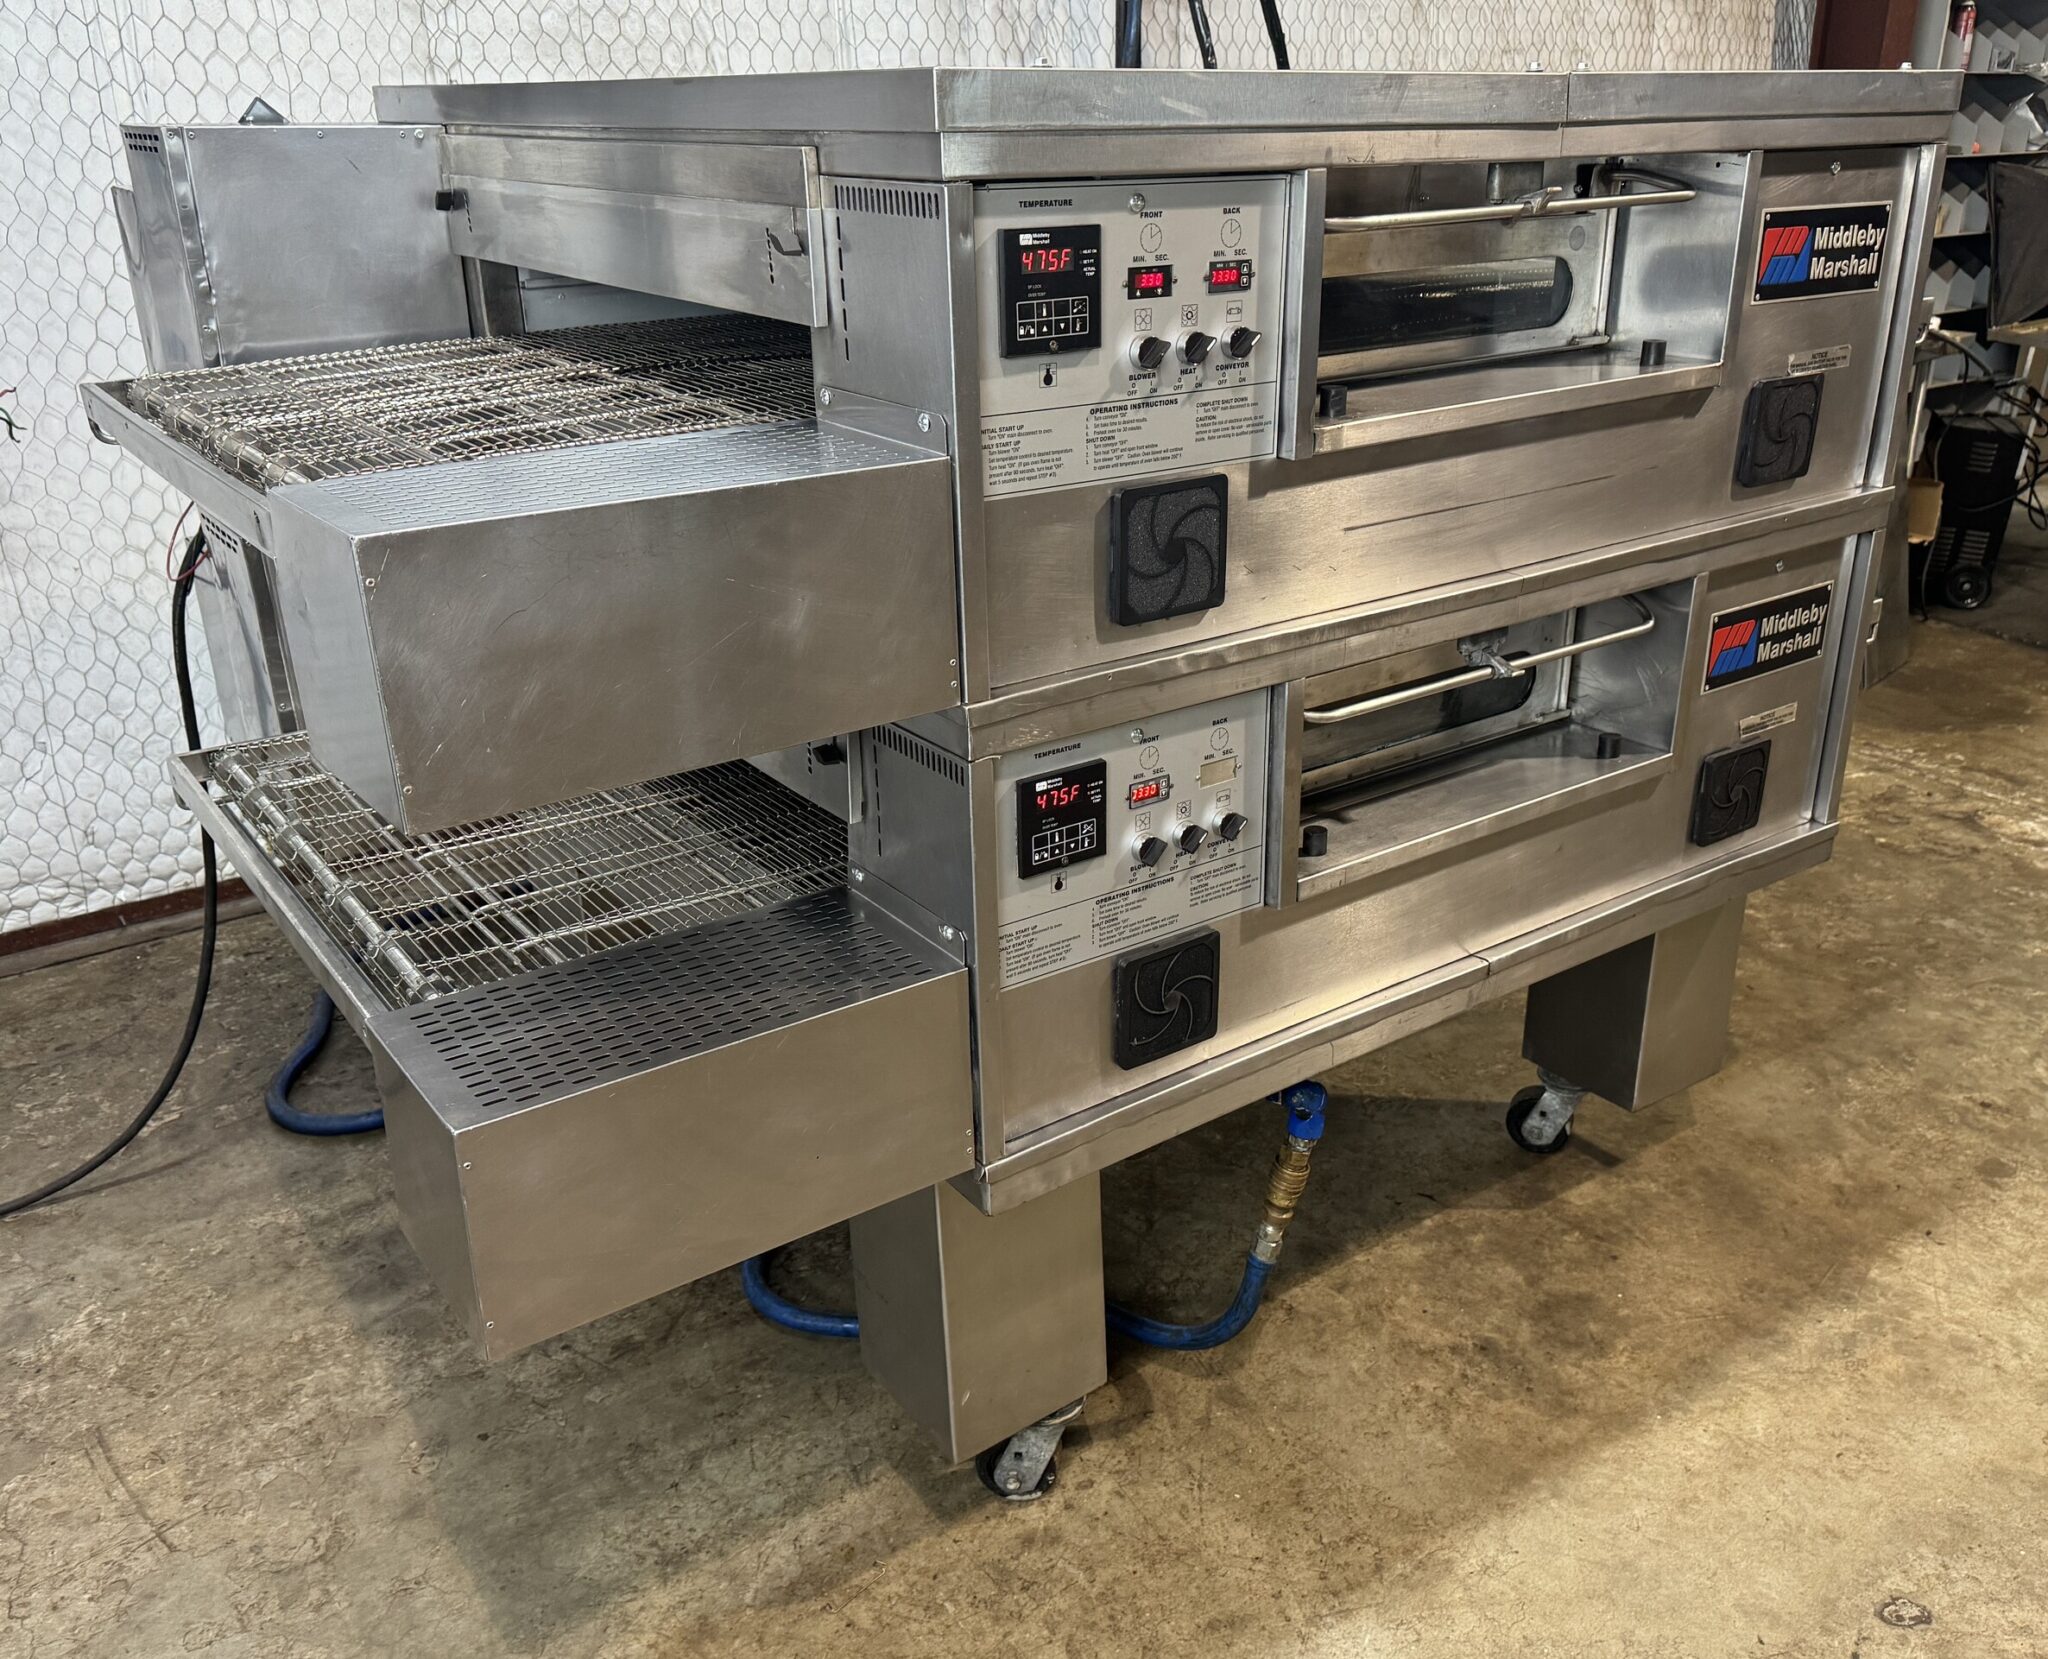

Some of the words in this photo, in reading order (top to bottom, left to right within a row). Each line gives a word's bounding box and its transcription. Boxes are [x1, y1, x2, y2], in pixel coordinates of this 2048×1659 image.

[1019, 199, 1072, 208] TEMPERATURE
[1814, 223, 1886, 250] Middleby
[1022, 249, 1072, 270] 475F
[1810, 253, 1878, 280] Marshall
[1216, 362, 1249, 371] CONVEYOR
[1129, 372, 1156, 381] BLOWER
[1090, 405, 1128, 415] OPERATING
[1130, 398, 1178, 410] INSTRUCTIONS
[1196, 400, 1220, 408] COMPLETE
[981, 427, 997, 435] NITIAL
[1760, 603, 1828, 638] Middleby
[1757, 626, 1822, 663] Marshall
[1212, 717, 1227, 726] BACK
[1034, 743, 1081, 759] TEMPERATURE
[1222, 748, 1234, 756] SEC.
[1037, 785, 1080, 809] 475F
[1096, 891, 1130, 905] OPERATING
[1132, 877, 1174, 894] INSTRUCTIONS
